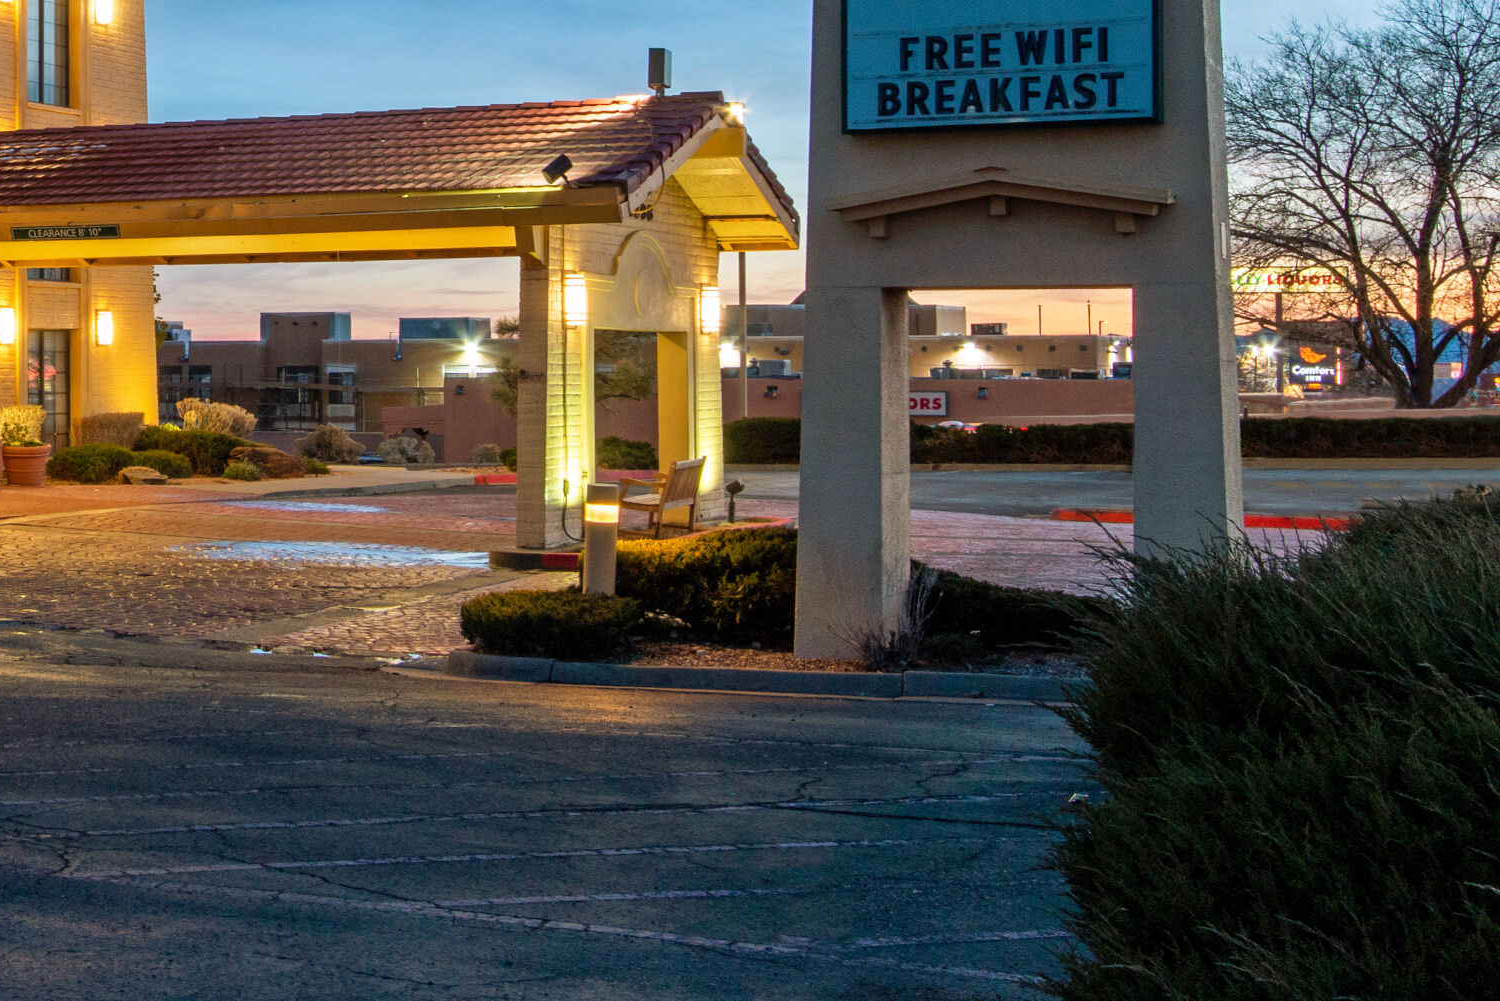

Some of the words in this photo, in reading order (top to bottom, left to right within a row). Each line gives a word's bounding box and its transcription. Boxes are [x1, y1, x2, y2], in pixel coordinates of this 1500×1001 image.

[899, 32, 1001, 72] FREE
[1015, 27, 1109, 66] WIFI
[877, 71, 1125, 117] BREAKFAST
[28, 228, 77, 238] CLEARANCE
[1292, 365, 1336, 375] Comfort
